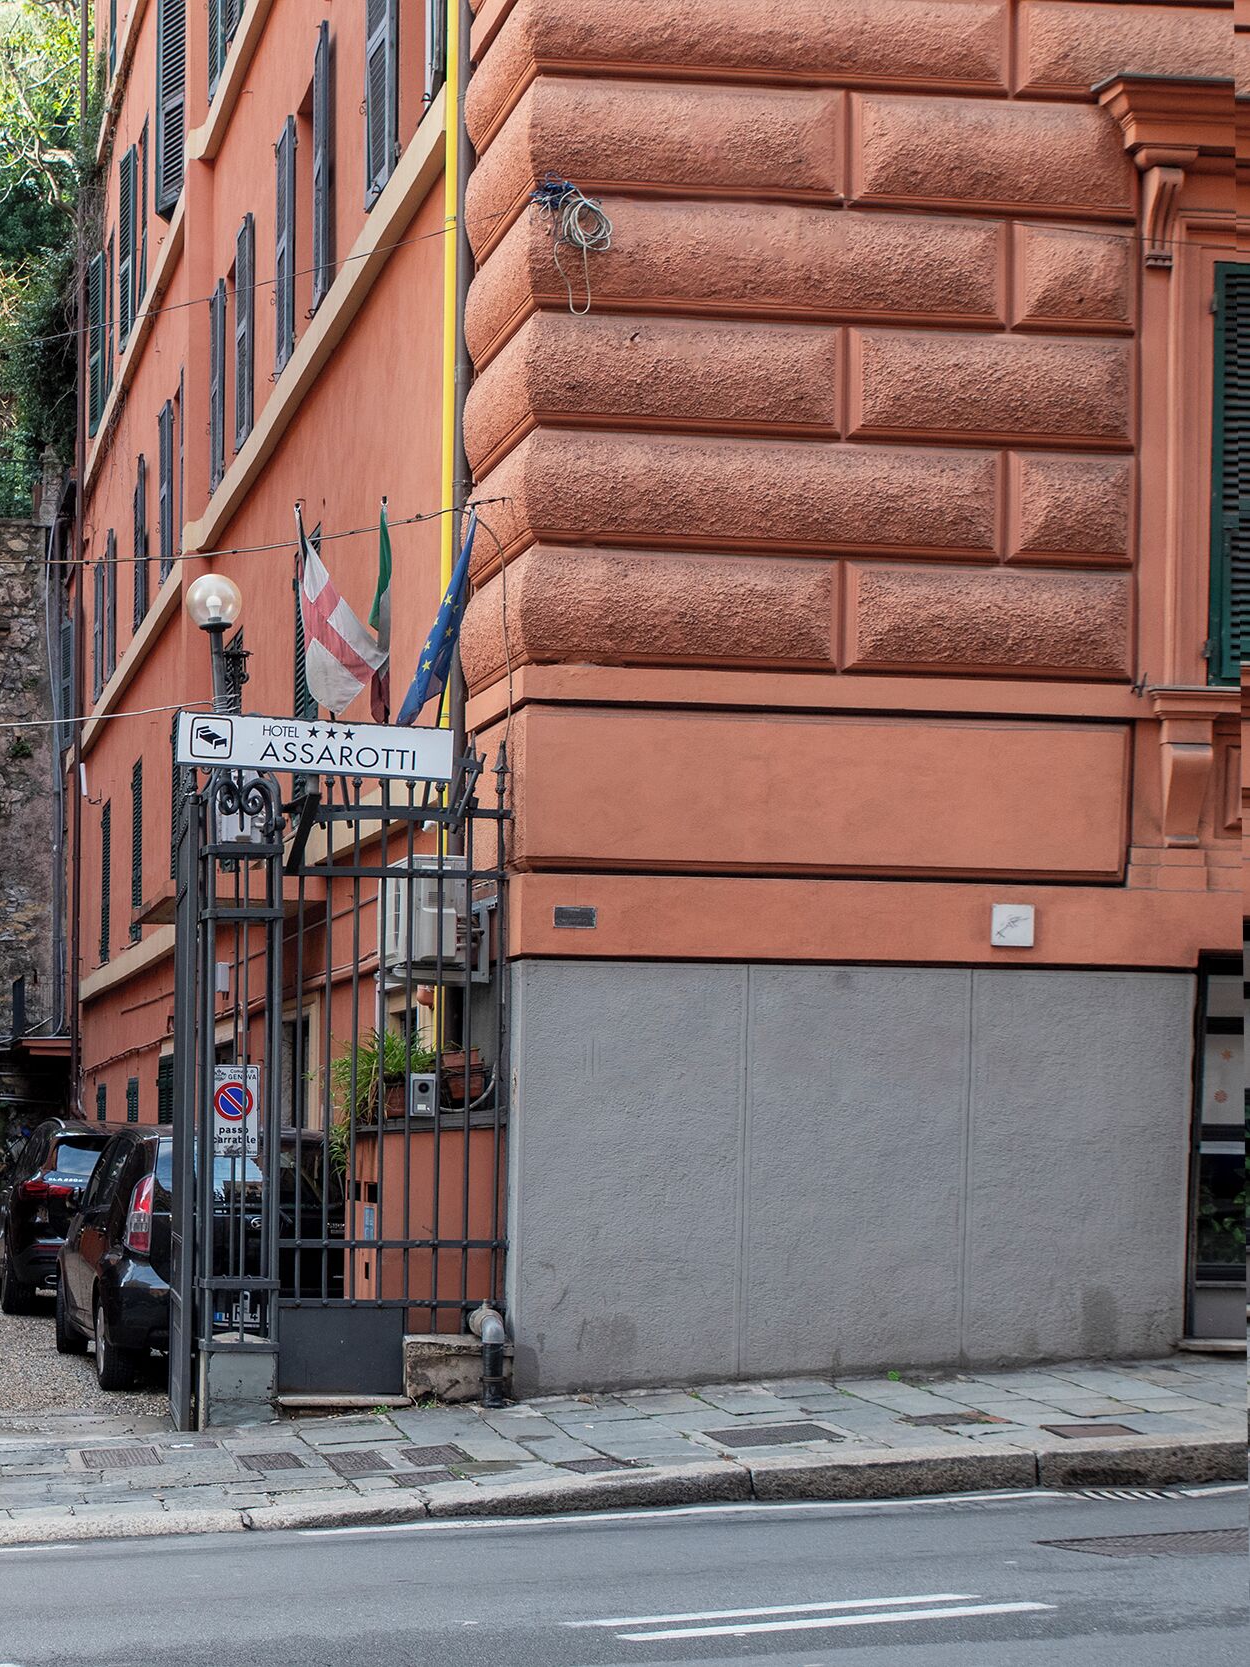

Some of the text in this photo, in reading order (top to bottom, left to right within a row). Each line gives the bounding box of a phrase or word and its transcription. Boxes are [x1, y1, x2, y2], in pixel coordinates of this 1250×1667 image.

[262, 725, 299, 738] HOTEL
[259, 741, 416, 771] ASSAROTTI
[213, 1135, 256, 1144] carrable
